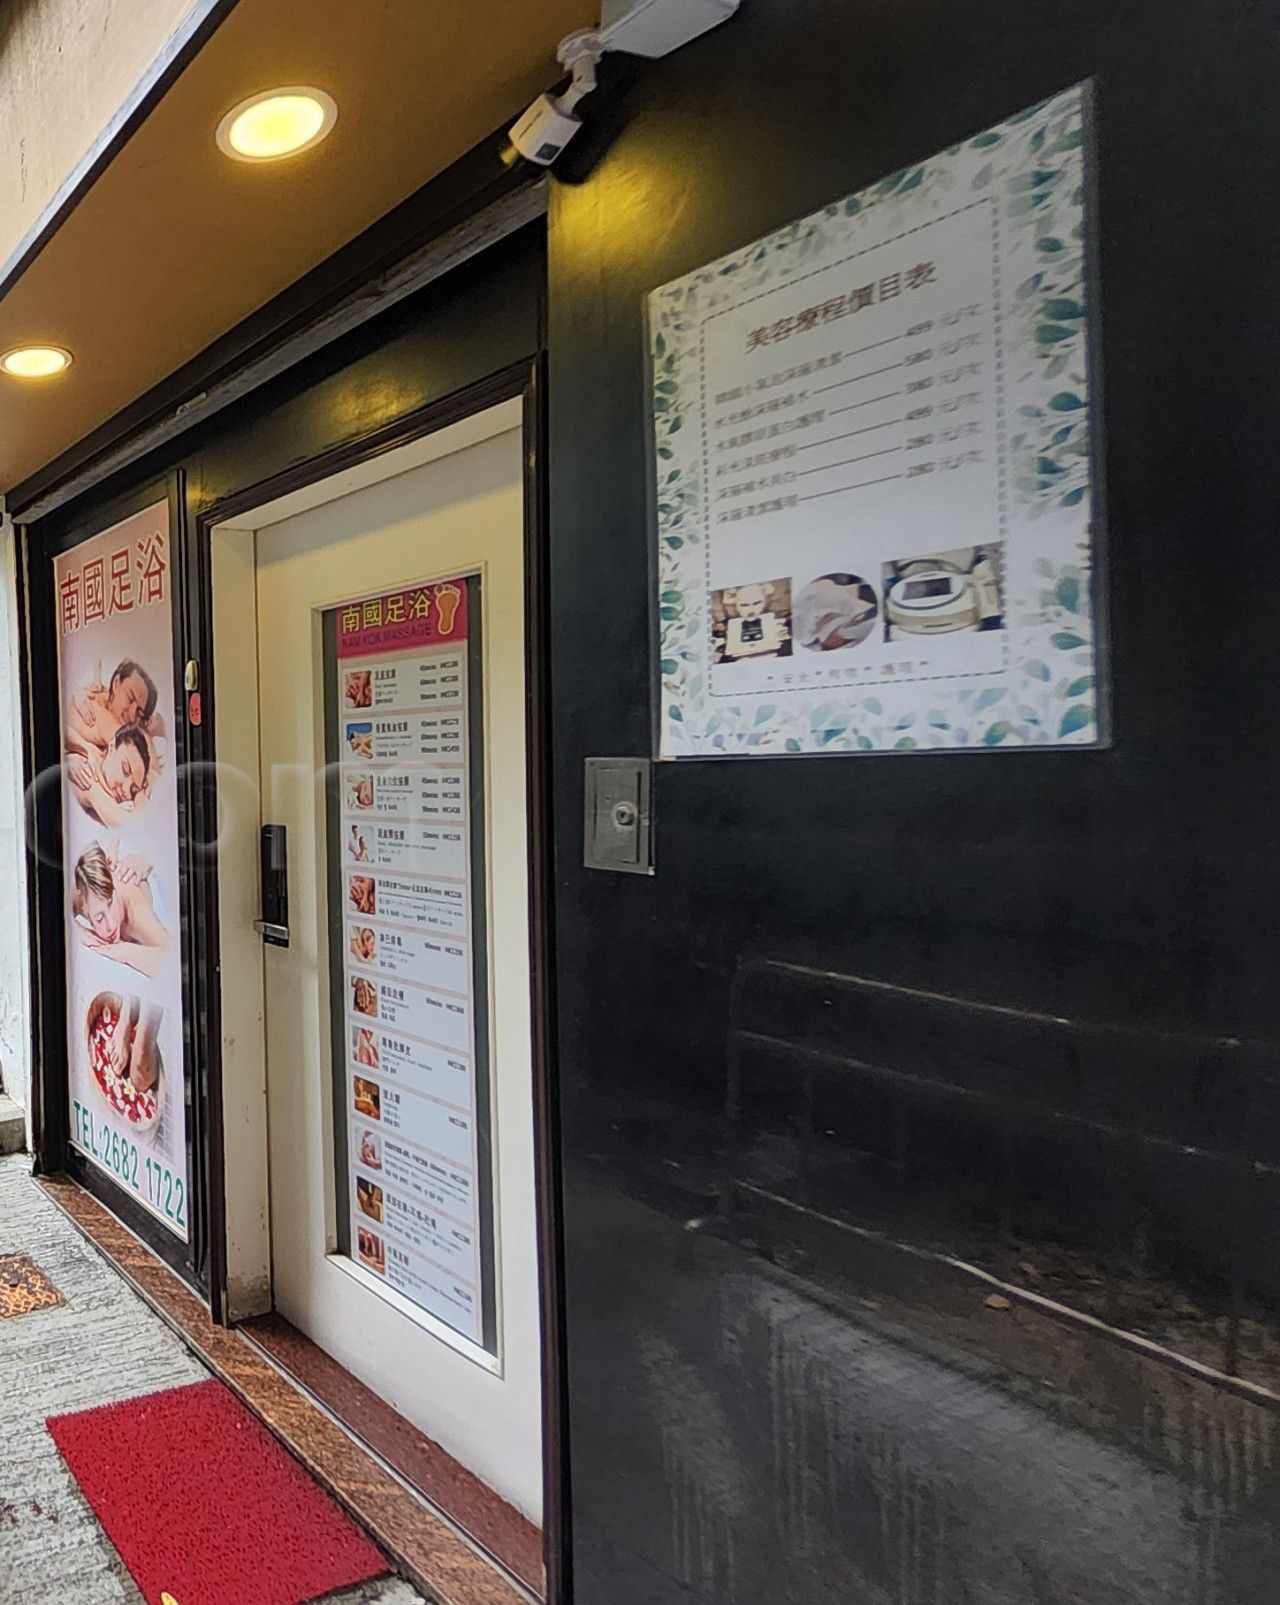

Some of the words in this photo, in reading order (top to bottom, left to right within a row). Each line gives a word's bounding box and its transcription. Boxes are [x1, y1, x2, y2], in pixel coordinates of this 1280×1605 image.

[60, 533, 166, 634] 南國足浴
[341, 588, 431, 634] 南國足浴
[73, 1099, 140, 1190] TEL:2682
[146, 1156, 186, 1228] 1722
